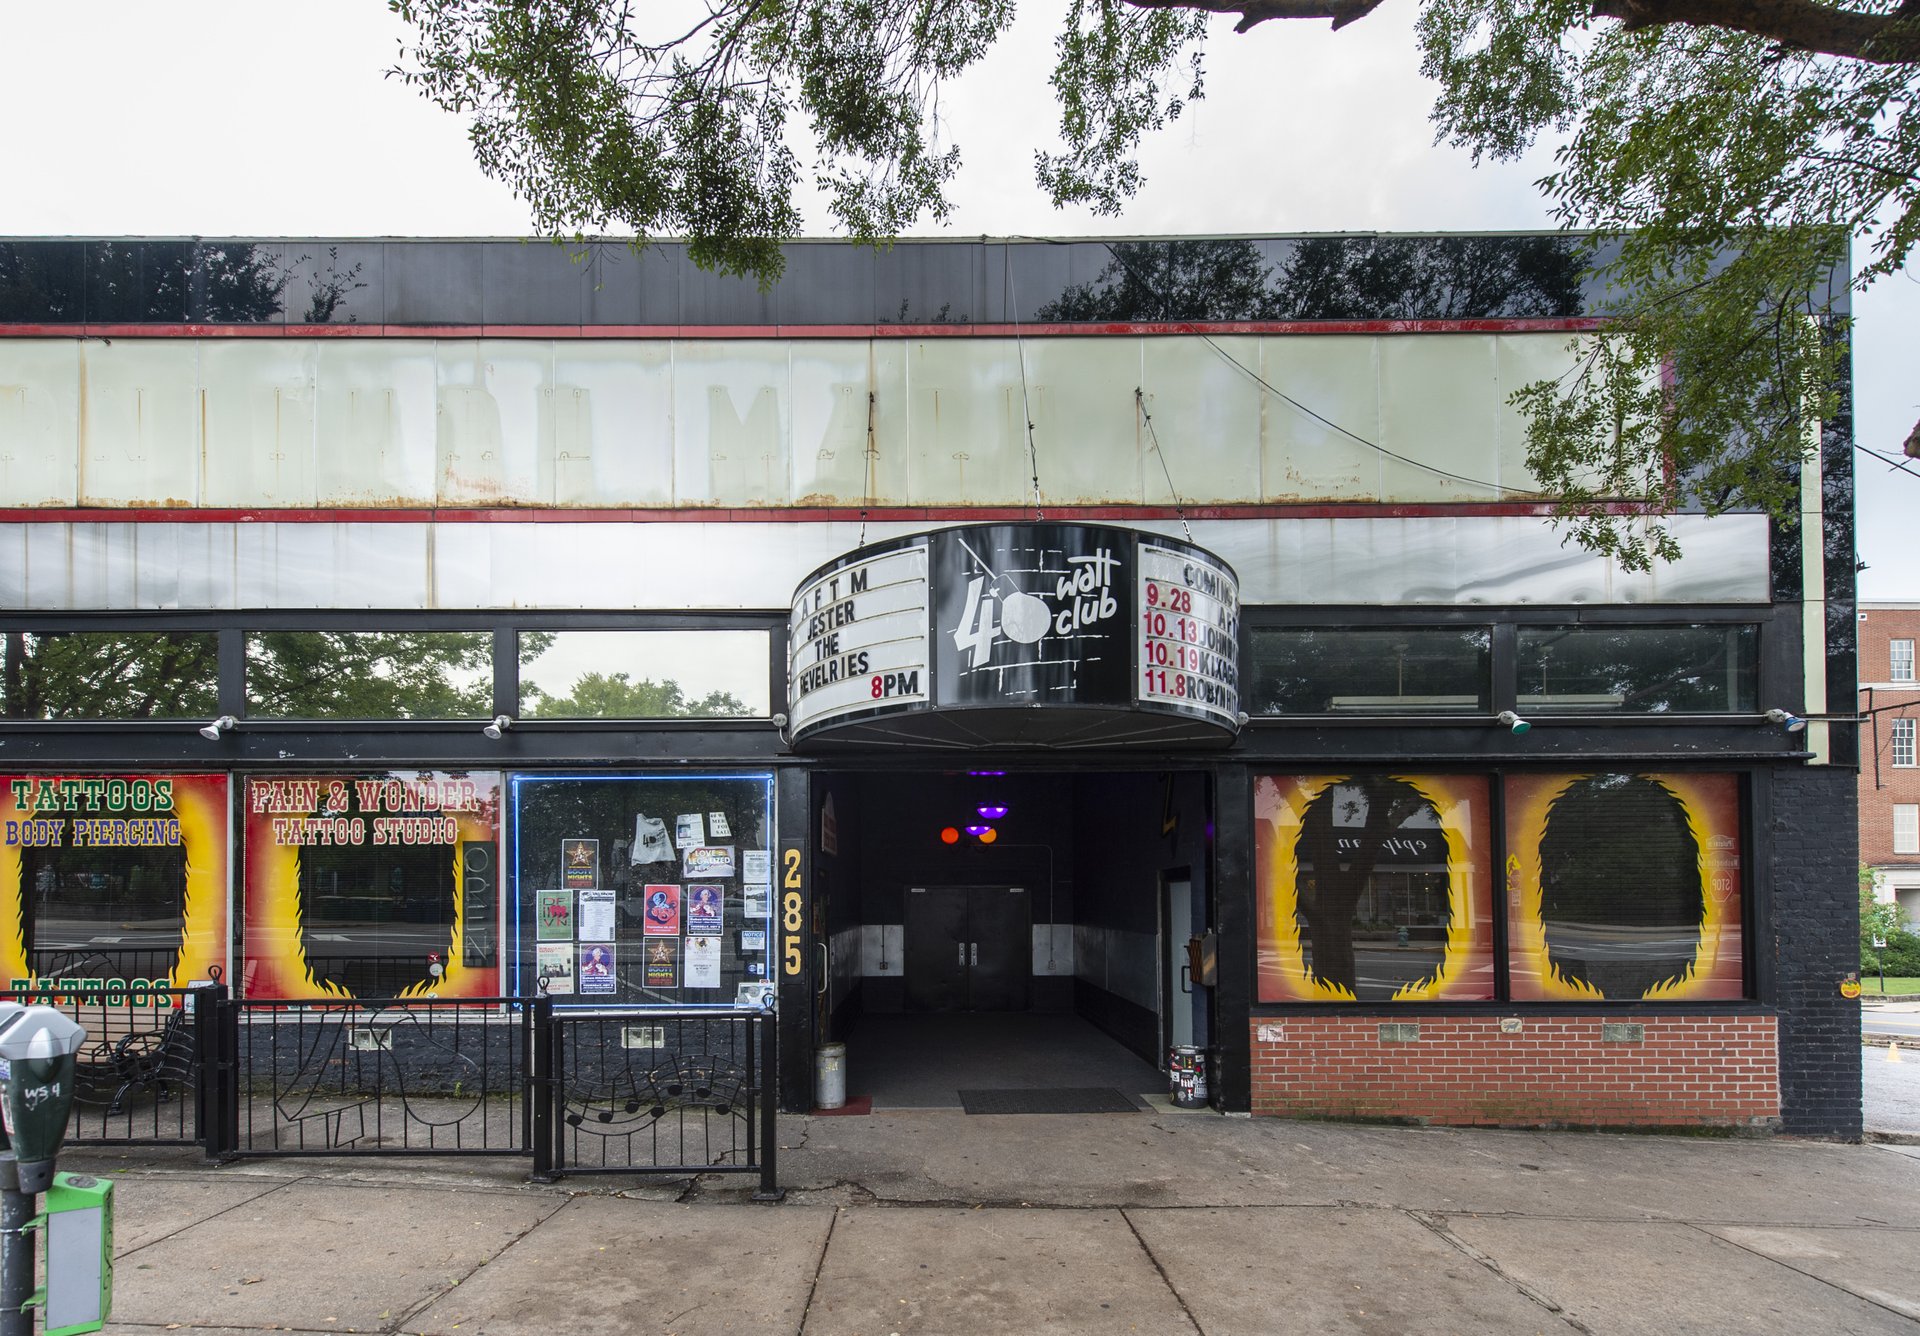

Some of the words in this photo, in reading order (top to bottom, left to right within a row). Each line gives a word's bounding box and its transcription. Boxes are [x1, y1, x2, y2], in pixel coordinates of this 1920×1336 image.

[1057, 548, 1122, 600] watt
[1184, 564, 1233, 607] COMING
[1056, 587, 1118, 635] club
[1147, 583, 1191, 613] 9.28
[807, 600, 855, 640] JESTER
[1144, 611, 1197, 642] 10.13
[815, 632, 839, 661] THE
[1145, 641, 1198, 671] 10.19
[871, 671, 918, 698] 8PM
[1145, 669, 1186, 696] 11.8
[11, 779, 175, 811] TATTOOS
[253, 780, 319, 813] PAIN
[328, 780, 349, 812] &
[355, 780, 480, 812] WONDER
[5, 819, 66, 846] BODY
[73, 819, 181, 846] PIERCING
[273, 817, 366, 845] TATTOO
[373, 817, 460, 845] STUDIO
[783, 848, 803, 976] 285
